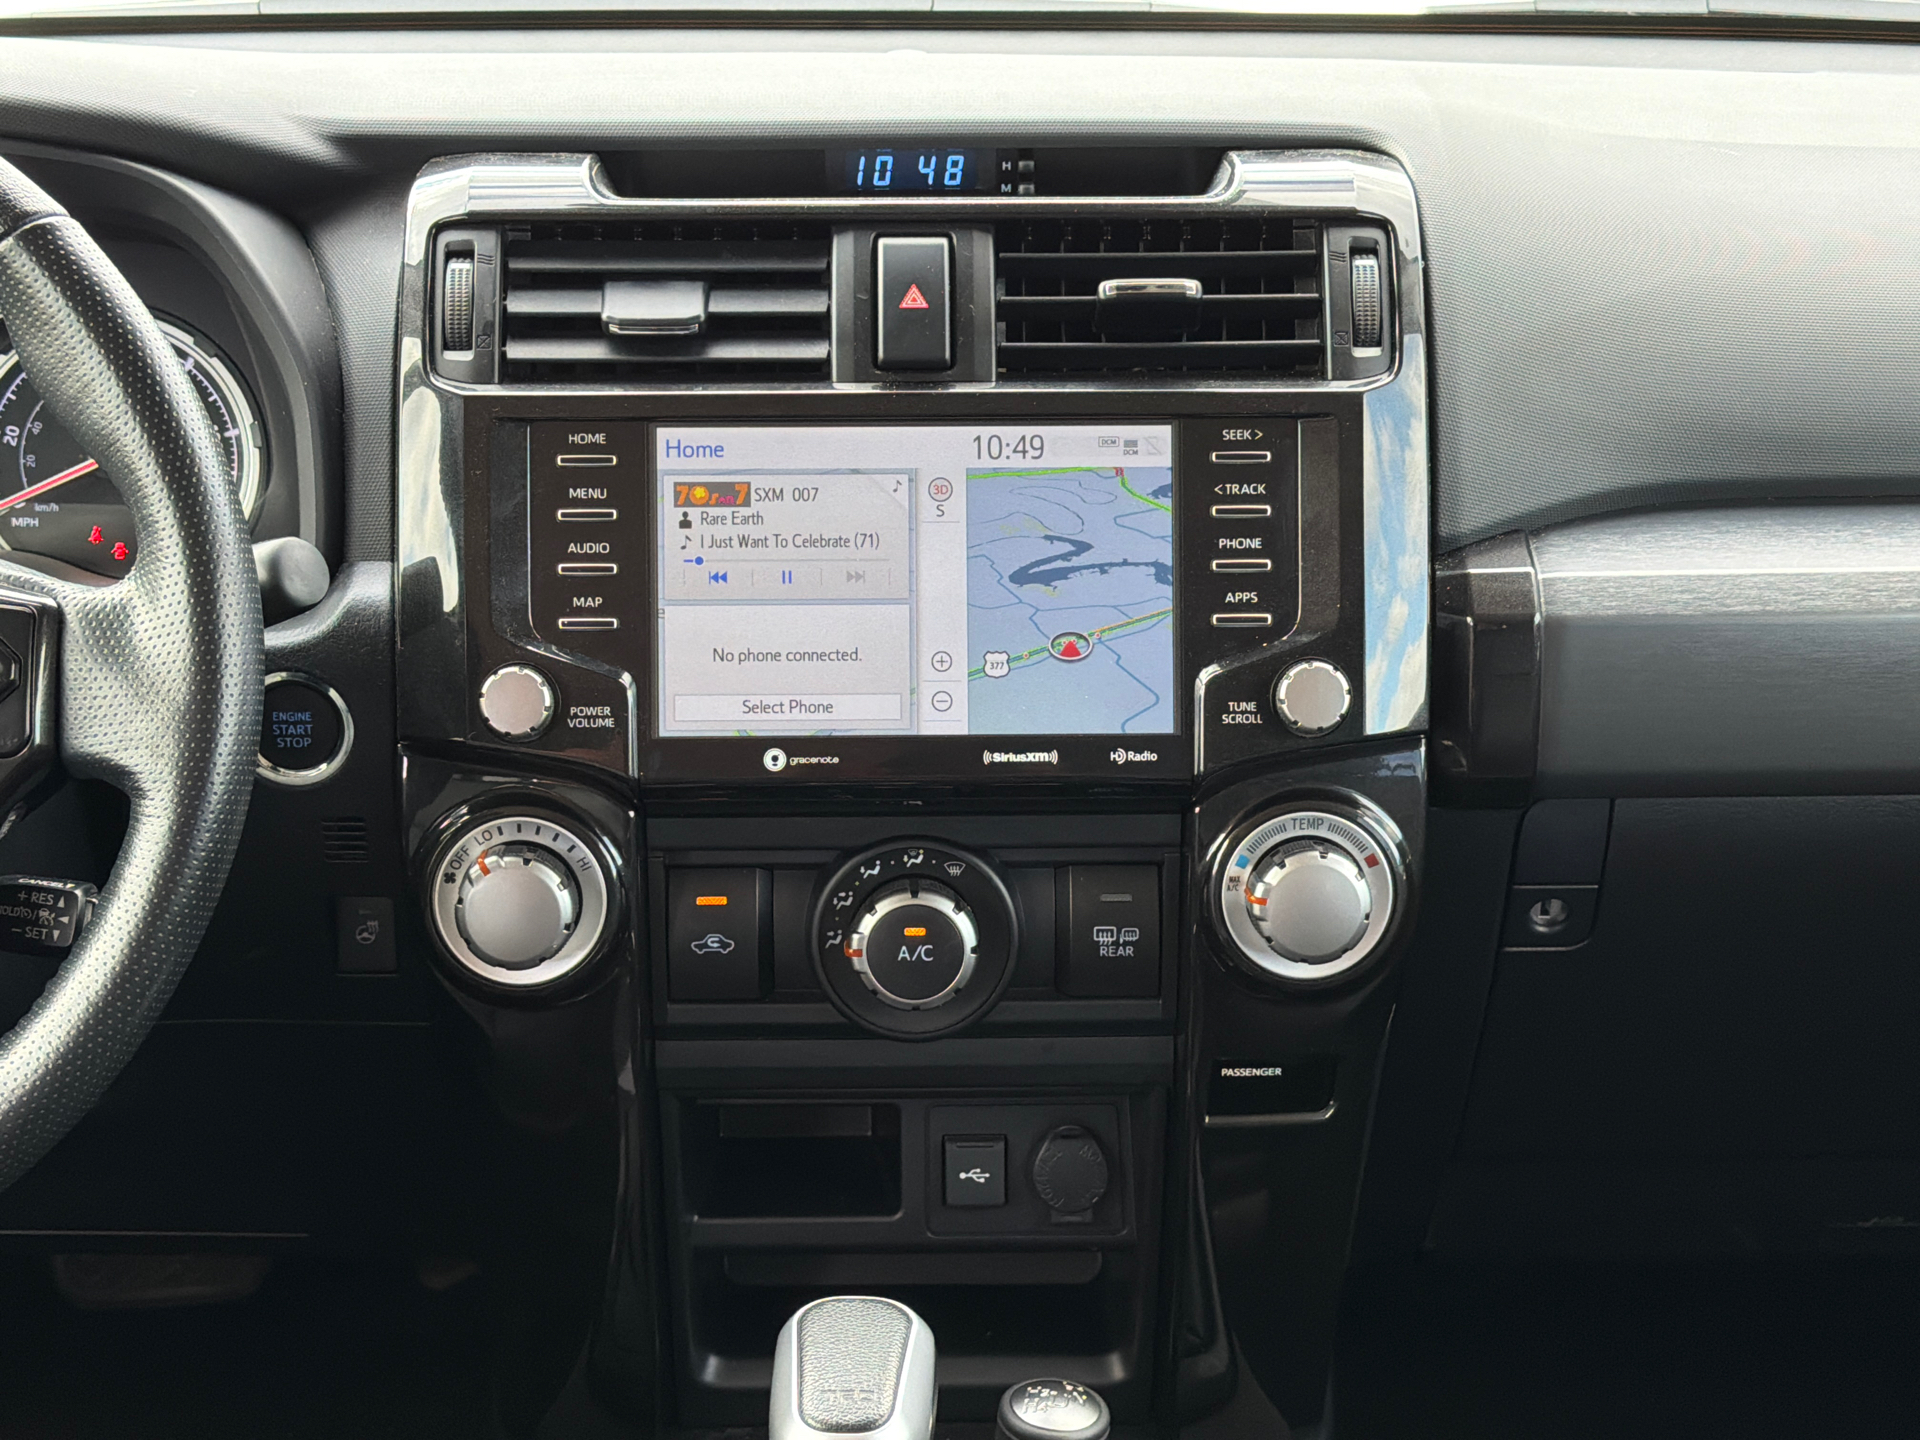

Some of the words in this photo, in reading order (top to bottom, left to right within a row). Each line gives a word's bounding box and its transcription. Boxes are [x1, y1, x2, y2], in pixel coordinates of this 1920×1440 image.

[857, 155, 893, 186] 10
[918, 155, 964, 186] 48
[1002, 161, 1011, 171] H
[1001, 184, 1012, 193] M
[31, 421, 43, 435] 40
[3, 425, 20, 447] 20
[568, 433, 607, 445] HOME
[1222, 429, 1252, 441] SEEK
[973, 434, 1045, 461] 10:49
[1101, 438, 1117, 446] DCM
[665, 439, 725, 459] Home
[1123, 448, 1139, 456] DCM
[26, 454, 36, 468] 20
[568, 488, 608, 500] MENU
[754, 487, 784, 502] SXM
[792, 487, 819, 502] 007
[933, 484, 949, 495] 3D
[1224, 484, 1267, 496] TRACK
[936, 504, 945, 518] S
[11, 517, 40, 528] MPH
[700, 511, 727, 526] Rare
[731, 510, 764, 526] Earth
[708, 533, 734, 549] Just
[737, 533, 769, 549] Want
[772, 533, 788, 549] To
[792, 533, 851, 549] Celebrate
[854, 531, 880, 551] (71)
[1219, 537, 1263, 550] PHONE
[567, 542, 610, 554] AUDIO
[572, 597, 603, 608] MAP
[1225, 592, 1259, 604] APPS
[712, 648, 735, 663] No
[738, 648, 783, 666] phone
[786, 647, 863, 663] connected.
[990, 661, 1004, 670] 377
[570, 706, 612, 717] POWER
[742, 699, 785, 715] Select
[788, 699, 834, 714] Phone
[1228, 701, 1257, 712] TUNE
[272, 711, 312, 722] ENGINE
[1222, 713, 1263, 725] SCROLL
[567, 717, 616, 729] VOLUME
[272, 724, 313, 736] START
[276, 737, 312, 748] STOP
[789, 756, 840, 766] gracenote
[1128, 751, 1158, 762] Radio
[1292, 818, 1324, 831] TEMP
[450, 845, 471, 871] OFF
[474, 829, 493, 846] LO
[576, 856, 592, 872] HI
[1228, 876, 1241, 884] MAX
[1226, 883, 1240, 892] A/C
[30, 892, 55, 906] RES
[25, 926, 49, 940] SET
[897, 945, 934, 962] A/C
[1099, 946, 1134, 957] REAR
[1221, 1067, 1282, 1077] PASSENGER
